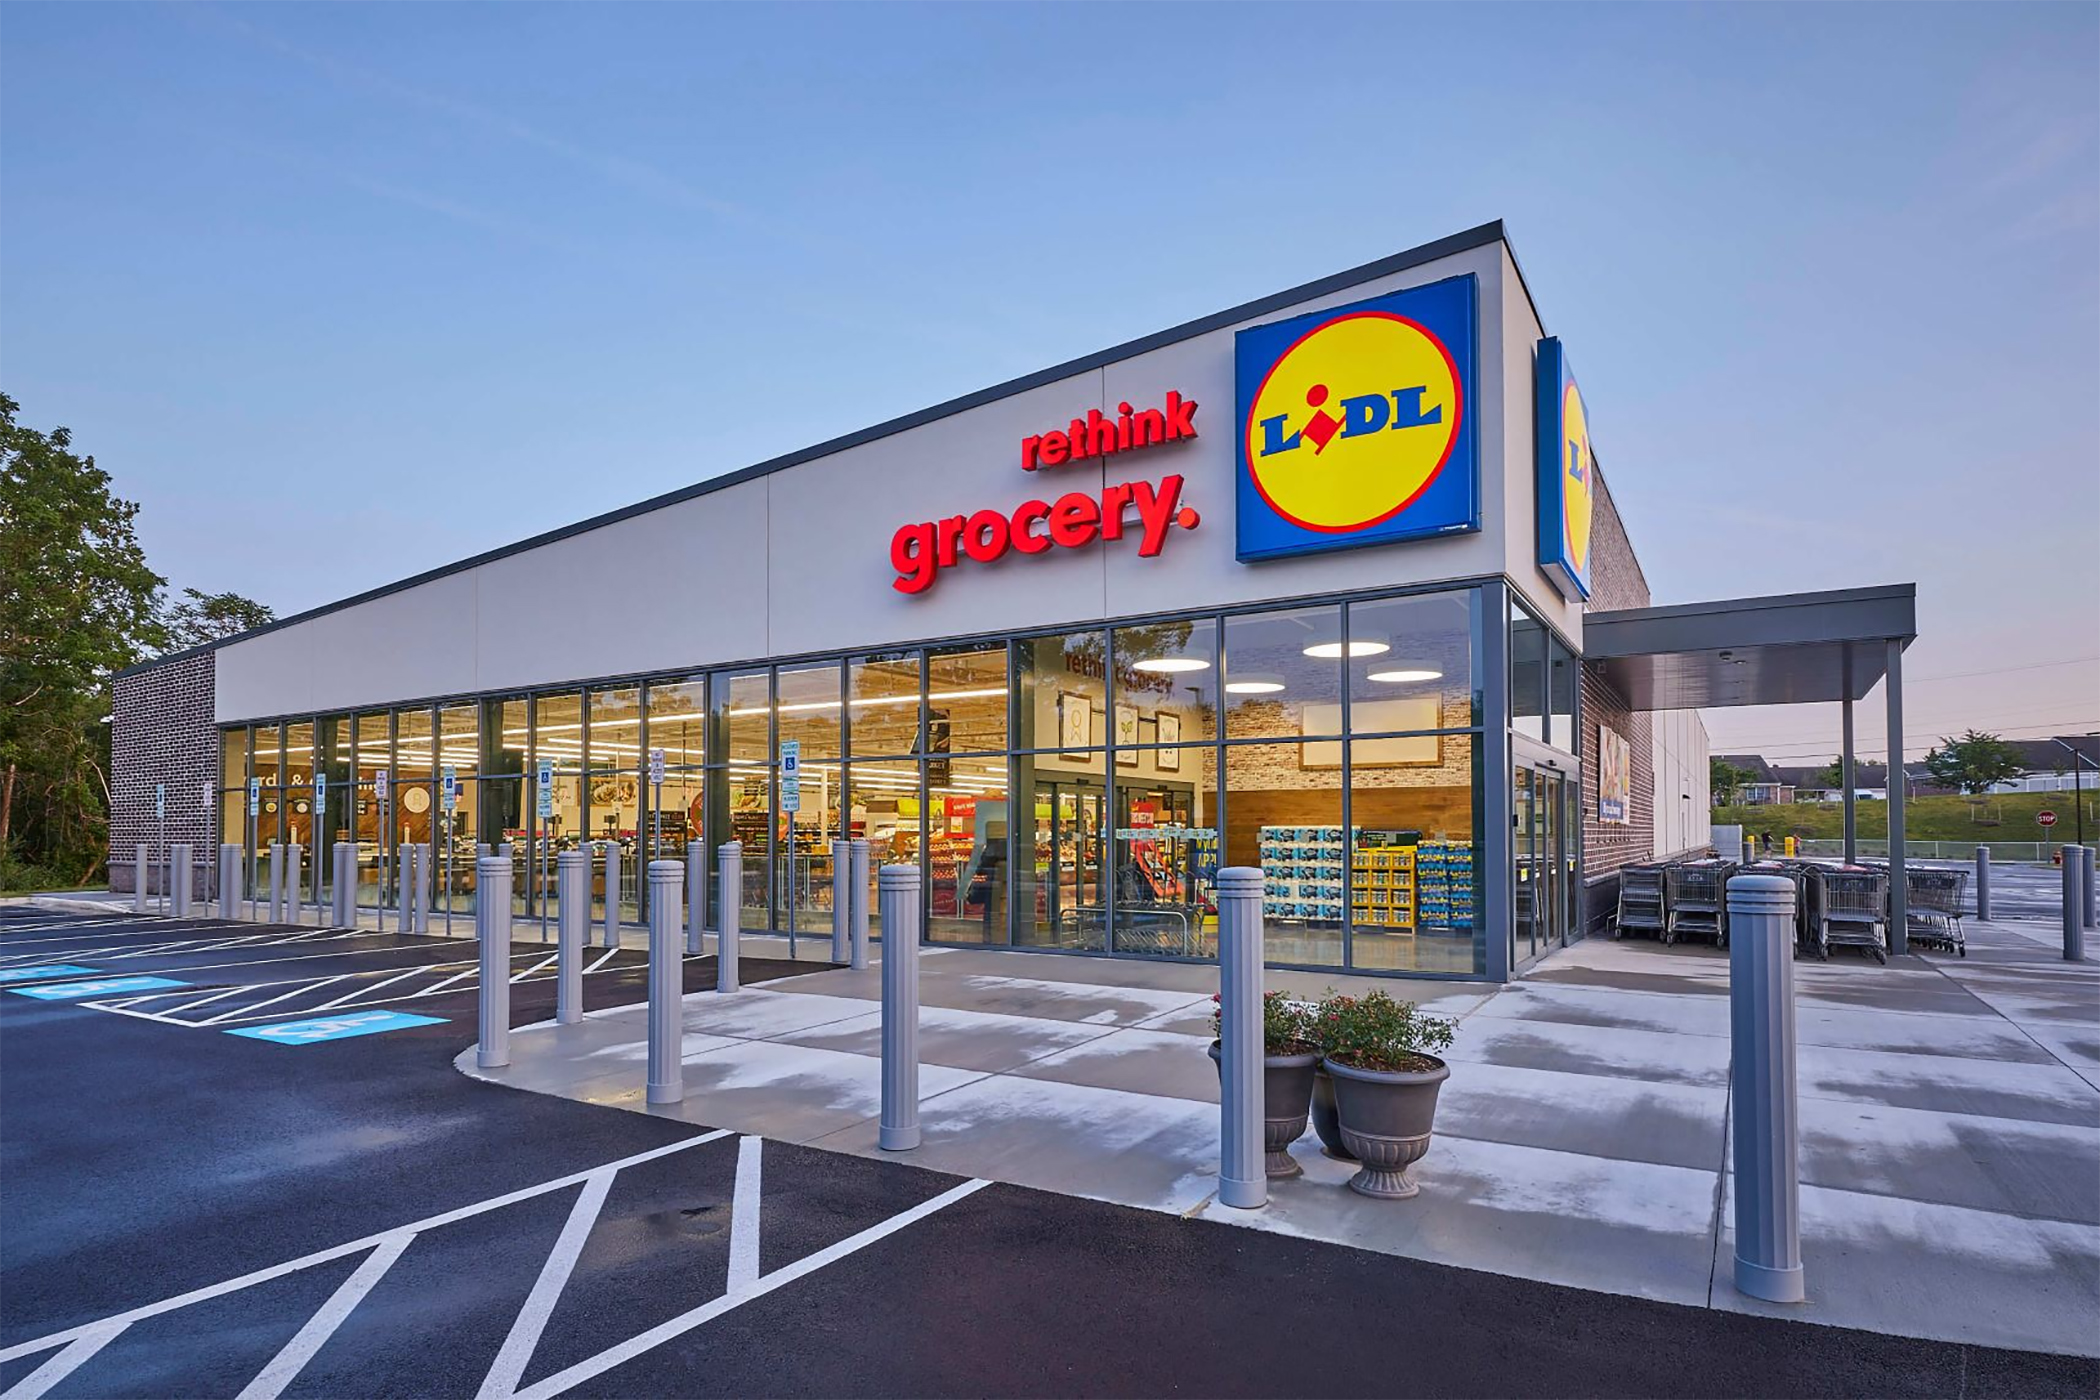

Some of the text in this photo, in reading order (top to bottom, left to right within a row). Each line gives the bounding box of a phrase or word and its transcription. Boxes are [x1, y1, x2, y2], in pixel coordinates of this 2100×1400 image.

[1021, 390, 1198, 472] rethink
[890, 473, 1201, 595] grocery.
[2038, 815, 2056, 823] STOP
